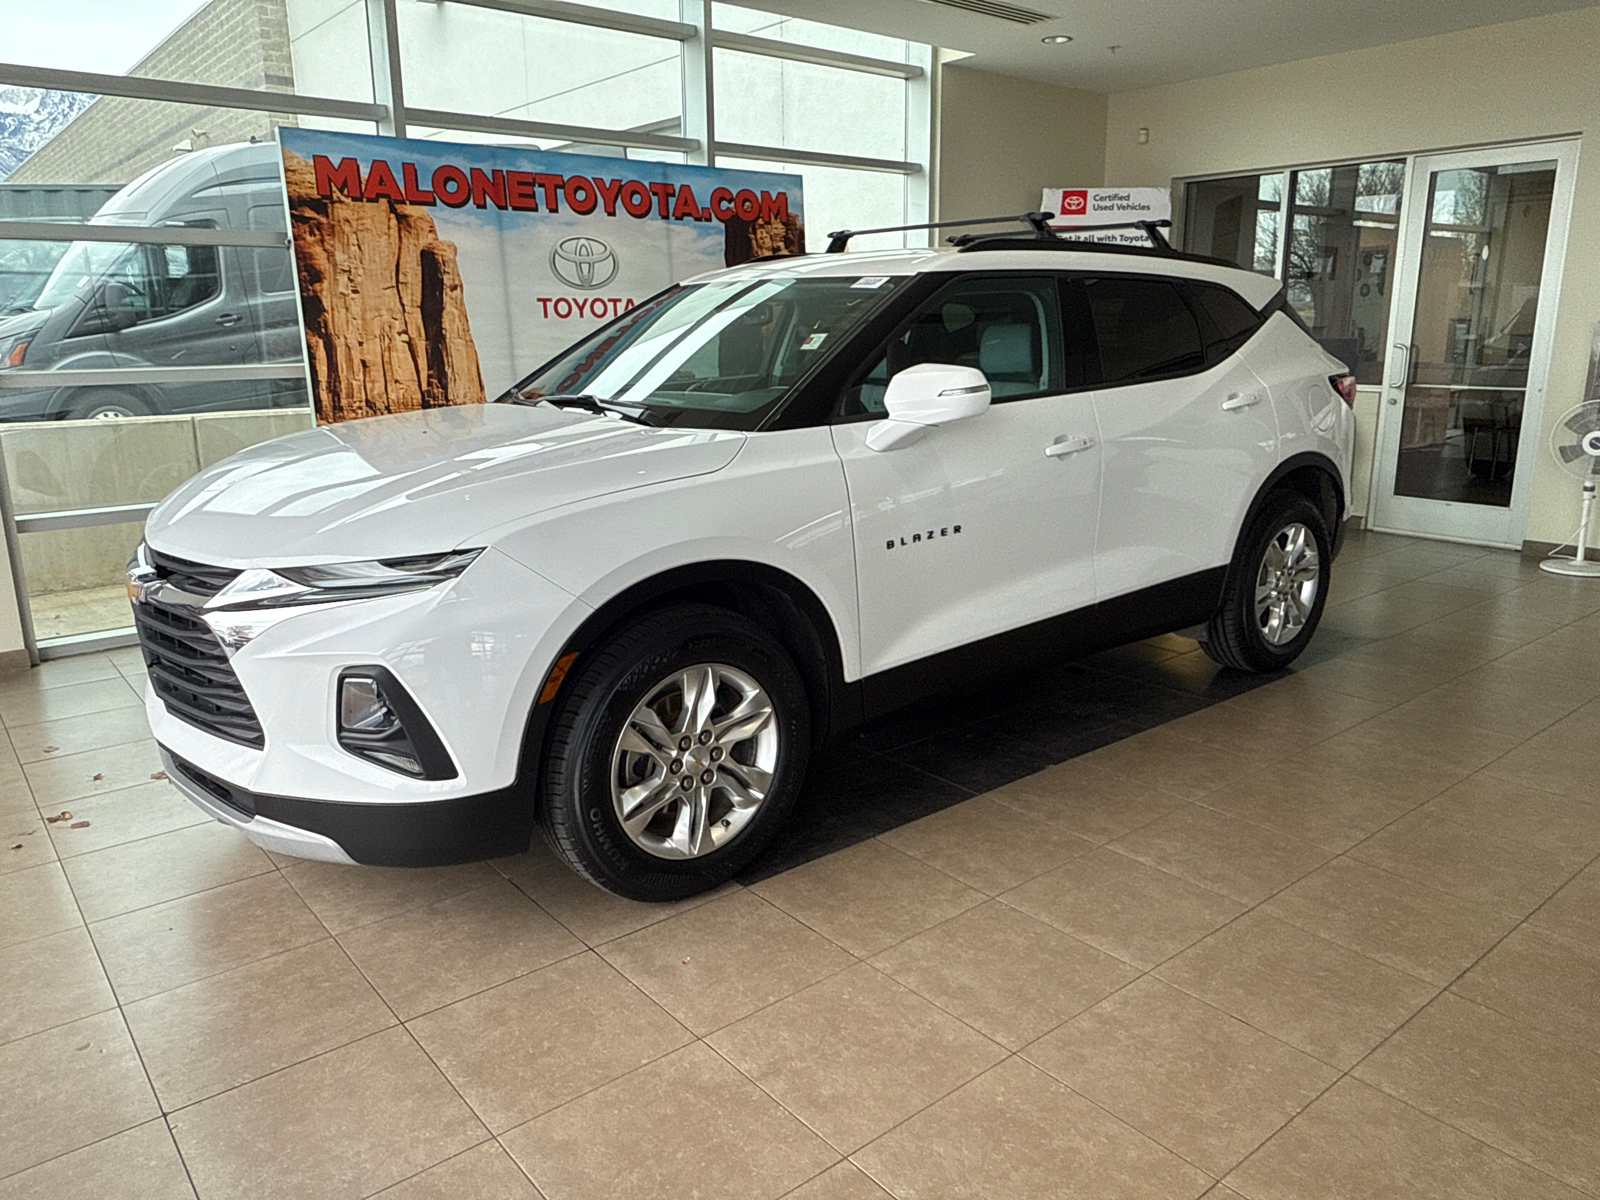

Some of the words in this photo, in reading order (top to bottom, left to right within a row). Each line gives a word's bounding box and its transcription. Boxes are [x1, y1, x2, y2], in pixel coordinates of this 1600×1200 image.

[312, 154, 789, 222] MALONETOYOTA.COM
[1093, 193, 1131, 202] Certified
[1092, 203, 1115, 212] Used
[1116, 202, 1151, 211] Vehicles
[1083, 234, 1095, 242] all
[1096, 234, 1118, 242] with
[1119, 234, 1150, 244] Toyota
[886, 525, 962, 550] BLAZER
[589, 806, 630, 871] KUMHO
